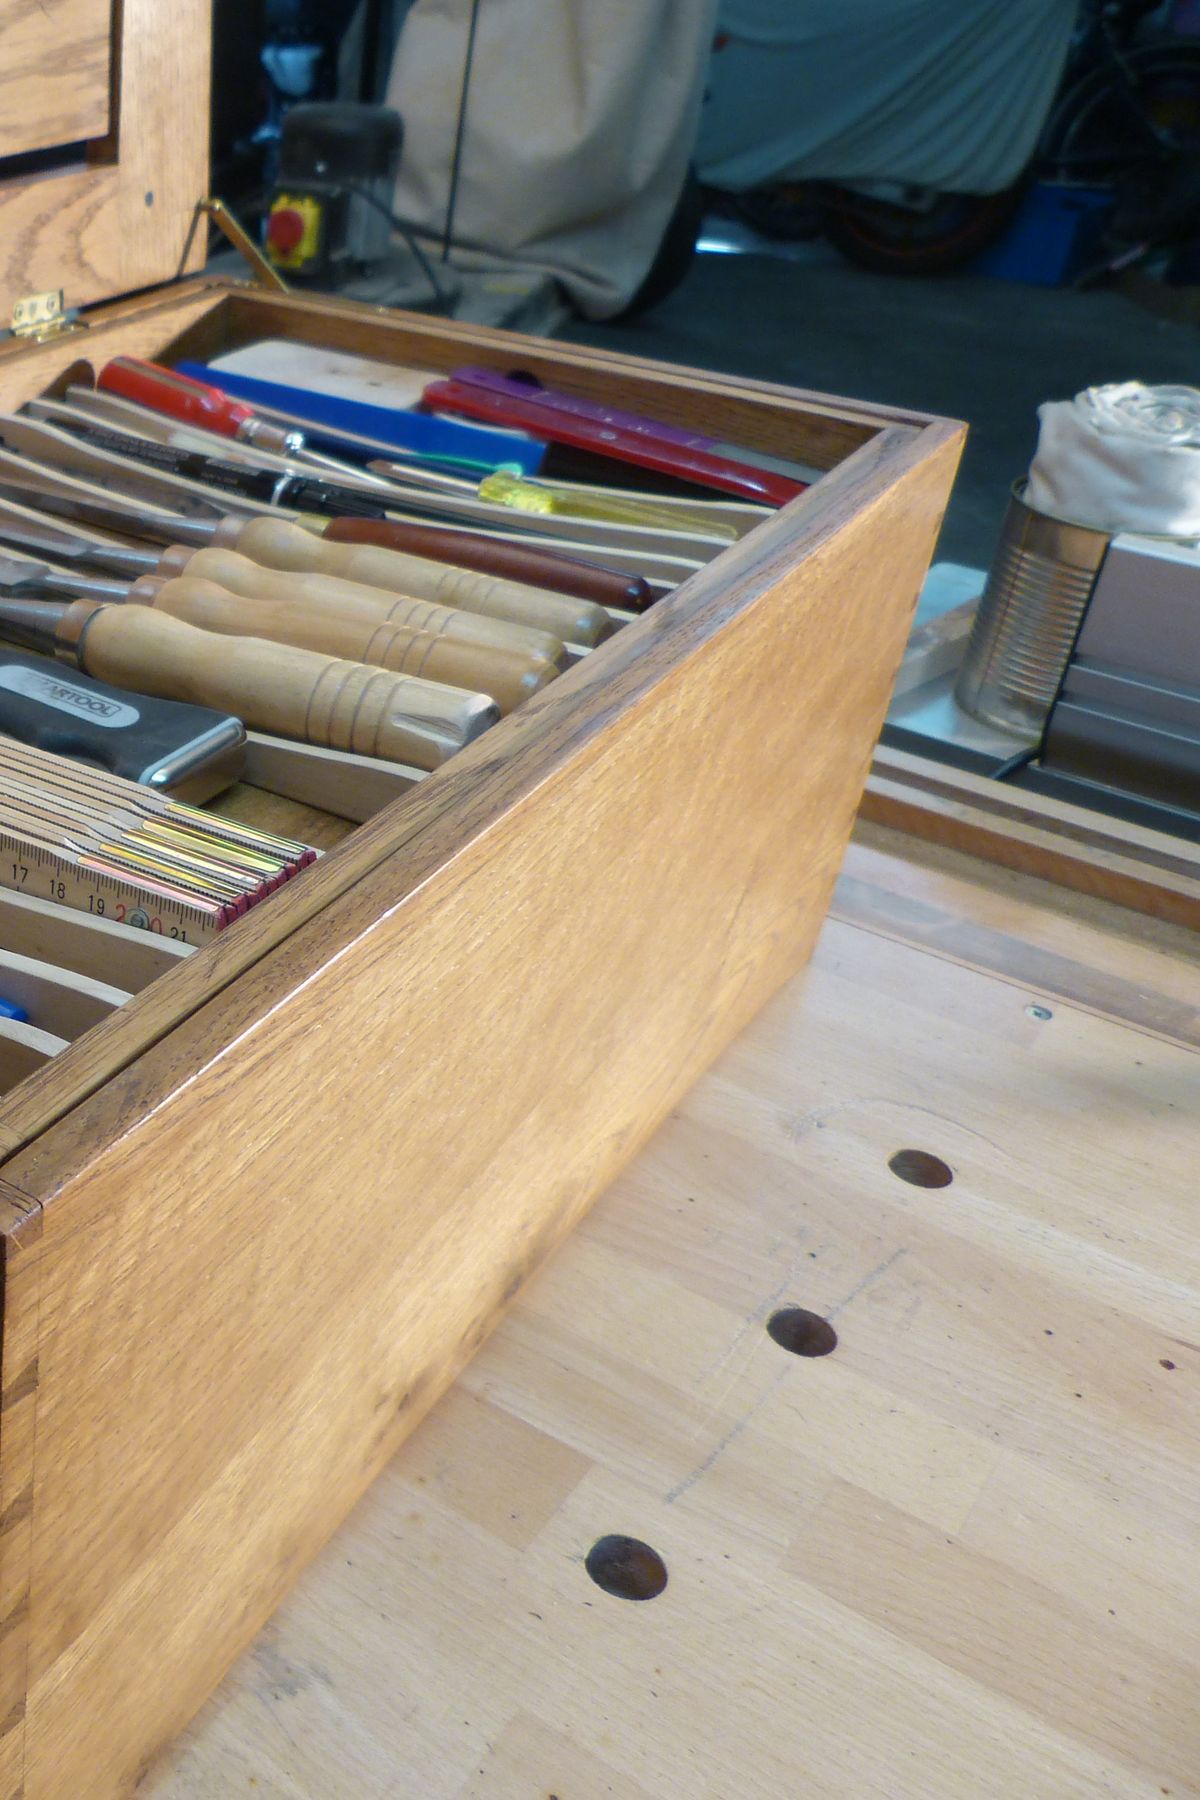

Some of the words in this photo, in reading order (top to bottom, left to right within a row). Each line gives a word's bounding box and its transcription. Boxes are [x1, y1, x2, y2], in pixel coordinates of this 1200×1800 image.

[13, 864, 28, 883] 17
[50, 879, 66, 899] 18
[88, 895, 105, 915] 19
[170, 926, 187, 943] 21
